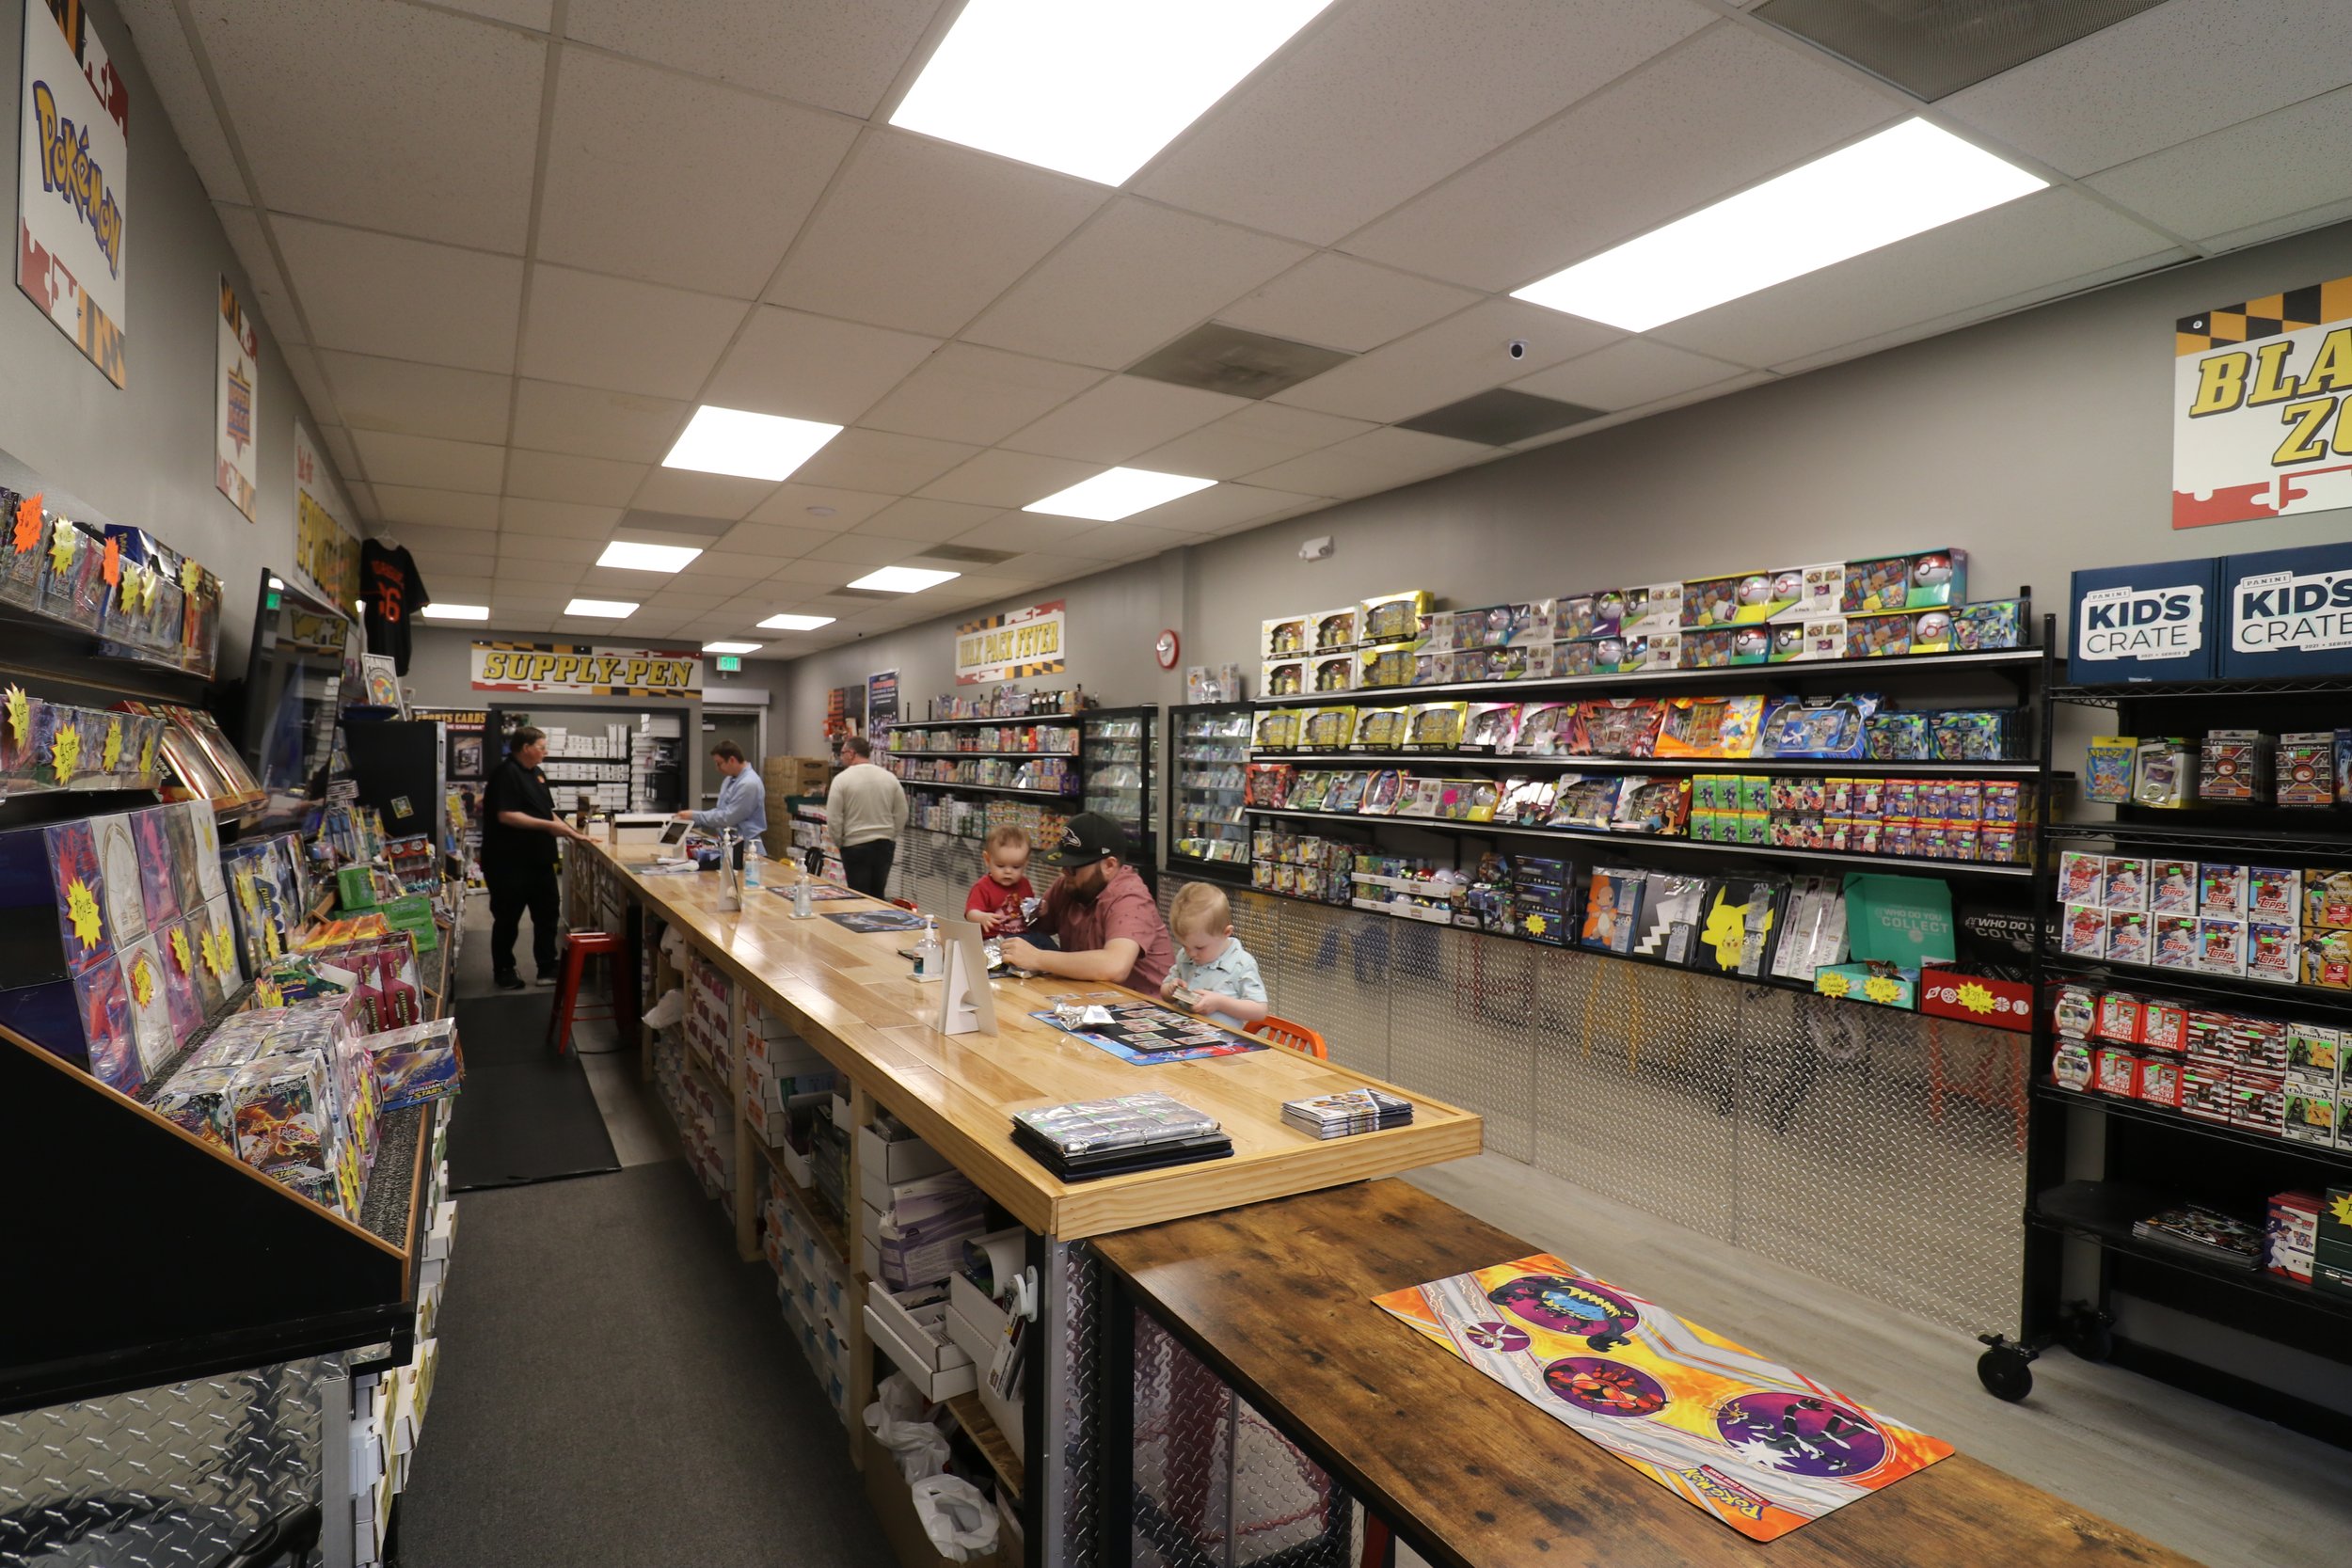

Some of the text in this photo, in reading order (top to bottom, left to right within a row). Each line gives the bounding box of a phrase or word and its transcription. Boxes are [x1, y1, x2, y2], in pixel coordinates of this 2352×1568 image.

[33, 80, 122, 280] Pokémon
[2247, 576, 2287, 586] PANINI
[2092, 591, 2127, 599] PANINI
[2243, 576, 2352, 620] KID'S
[2089, 593, 2192, 630] KID'S
[2242, 612, 2352, 644] CRATE
[984, 630, 1014, 665] PACK
[1016, 621, 1059, 659] FEVER
[2087, 625, 2188, 654] CRATE
[484, 652, 693, 687] SUPPLY-PEN
[721, 656, 739, 671] EXIT
[454, 712, 486, 723] CARDS
[1923, 911, 1942, 922] YOU
[1672, 924, 1689, 935] 360
[1882, 917, 1949, 934] COLLECT
[2010, 921, 2026, 930] DO
[2030, 924, 2055, 934] YU
[1743, 933, 1763, 946] 360
[1976, 927, 2061, 944] COLLET
[2100, 1030, 2133, 1041] BASEBALL
[2292, 1029, 2336, 1042] Chronicles
[2144, 1037, 2179, 1050] BASEBALL
[407, 1082, 446, 1095] BRILLIANT
[414, 1087, 443, 1100] STARS
[2098, 1084, 2131, 1096] BASEBALL
[2288, 1087, 2333, 1101] Chronicles
[2142, 1093, 2175, 1105] BASEBALL
[1679, 1466, 1764, 1521] Pokémon
[1740, 1485, 1764, 1503] TRADING
